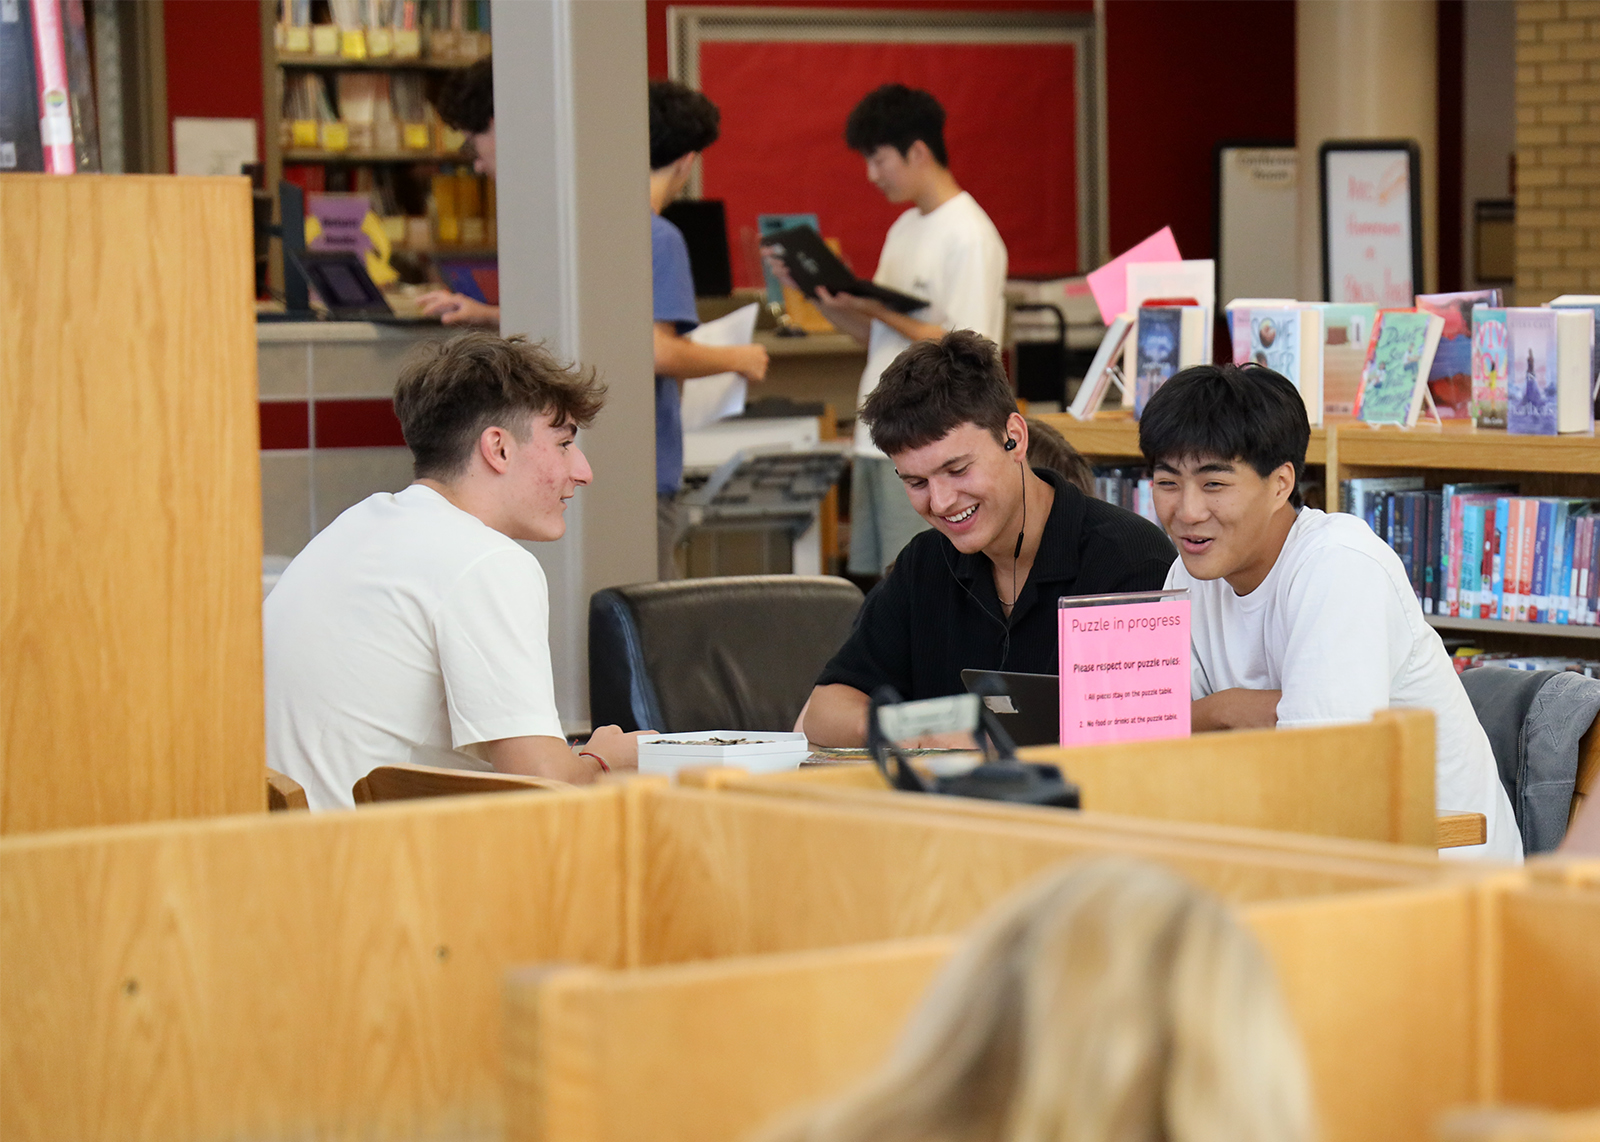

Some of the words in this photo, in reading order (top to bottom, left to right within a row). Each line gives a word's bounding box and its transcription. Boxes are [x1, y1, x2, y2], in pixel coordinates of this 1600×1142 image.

[1072, 617, 1110, 632] Puzzle
[1113, 616, 1124, 630] in
[1128, 615, 1181, 632] progress
[1073, 663, 1095, 674] Please
[1096, 660, 1122, 674] respect
[1123, 661, 1135, 669] our
[1137, 657, 1160, 671] puzzle
[1161, 656, 1181, 667] rules:
[1096, 692, 1111, 702] pieces
[1112, 691, 1123, 701] stay
[1131, 690, 1140, 698] the
[1141, 688, 1158, 699] puzzle
[1159, 687, 1173, 695] table.
[1095, 718, 1106, 727] food
[1114, 717, 1129, 725] drinks
[1146, 715, 1163, 726] puzzle
